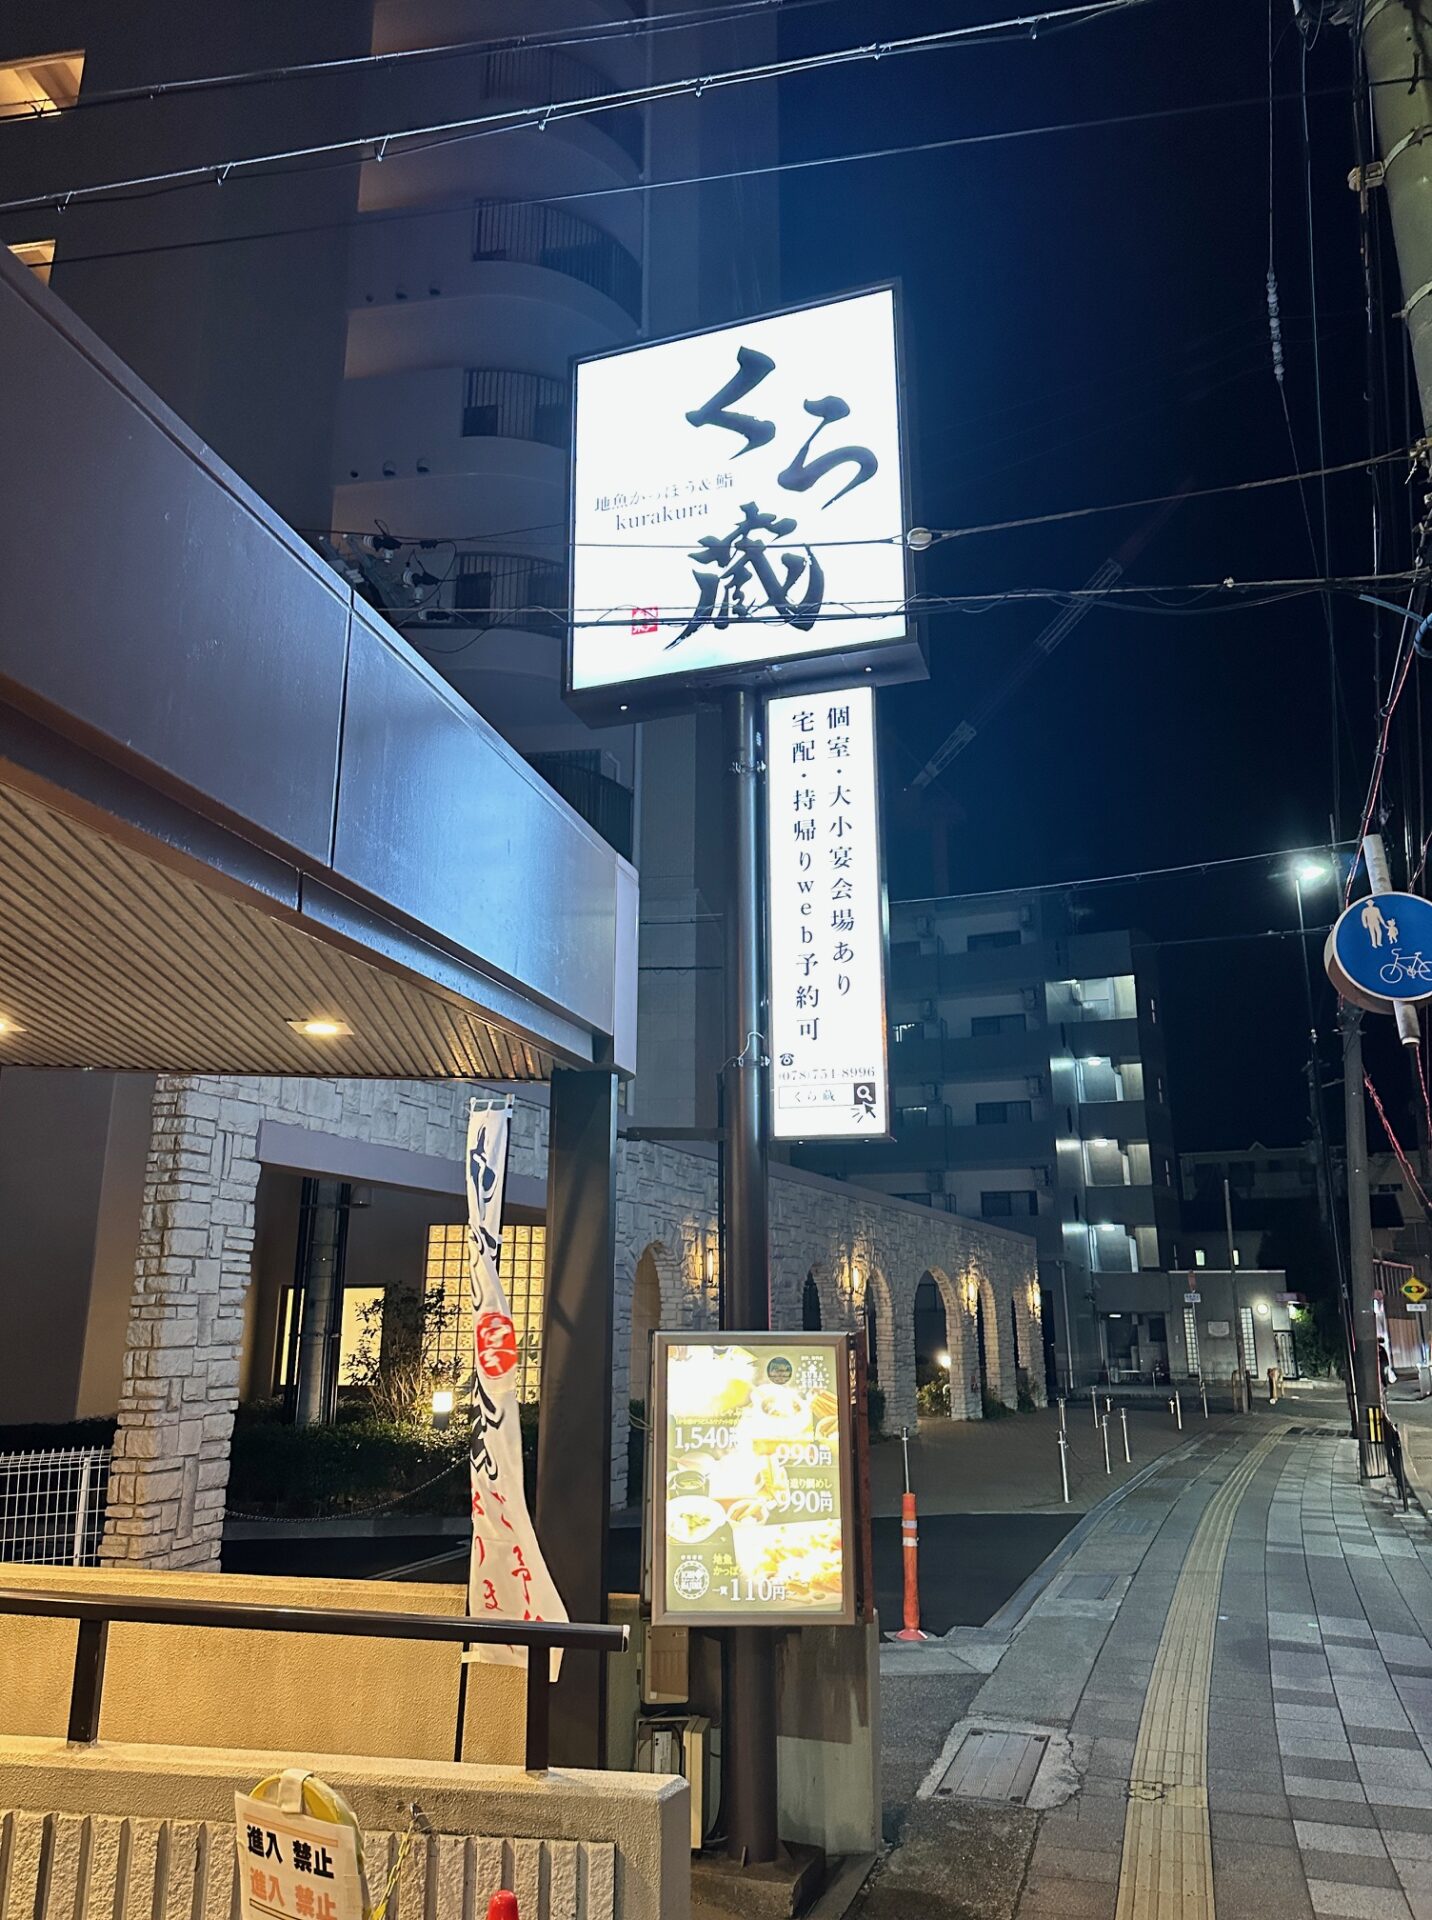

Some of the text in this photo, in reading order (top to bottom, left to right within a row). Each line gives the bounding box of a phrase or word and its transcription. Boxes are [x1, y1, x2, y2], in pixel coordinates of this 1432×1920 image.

[616, 503, 708, 531] kurakura
[791, 710, 820, 1042] 宅配・持帰りweb予約可
[826, 705, 855, 997] 個室・大小宴会場あり
[246, 1823, 335, 1880] 進入 禁止
[250, 1867, 285, 1908] 進入
